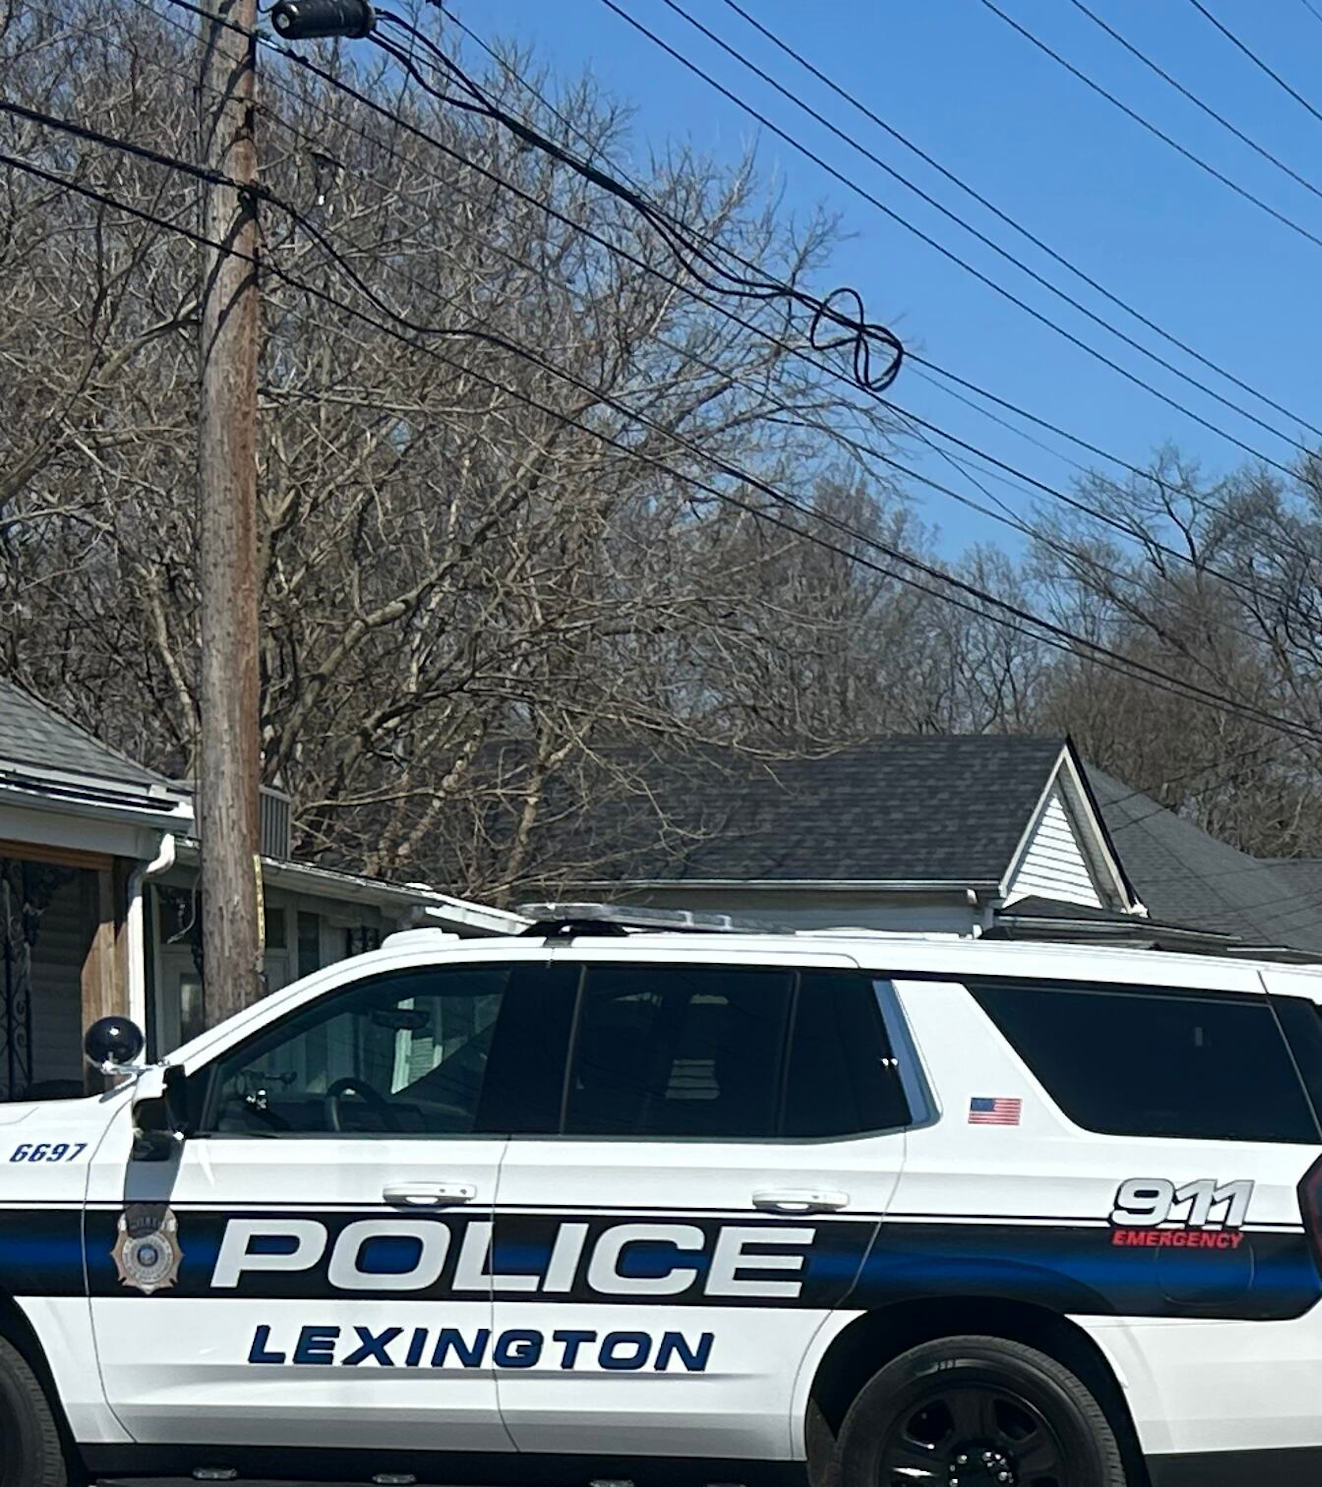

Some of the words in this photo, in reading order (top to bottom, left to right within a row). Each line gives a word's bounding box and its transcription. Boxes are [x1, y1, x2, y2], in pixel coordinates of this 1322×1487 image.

[9, 1142, 89, 1163] 6697
[1109, 1177, 1255, 1228] 911
[210, 1218, 816, 1298] POLICE
[1111, 1230, 1244, 1249] EMERGENCY
[247, 1325, 714, 1372] LEXINGTON
